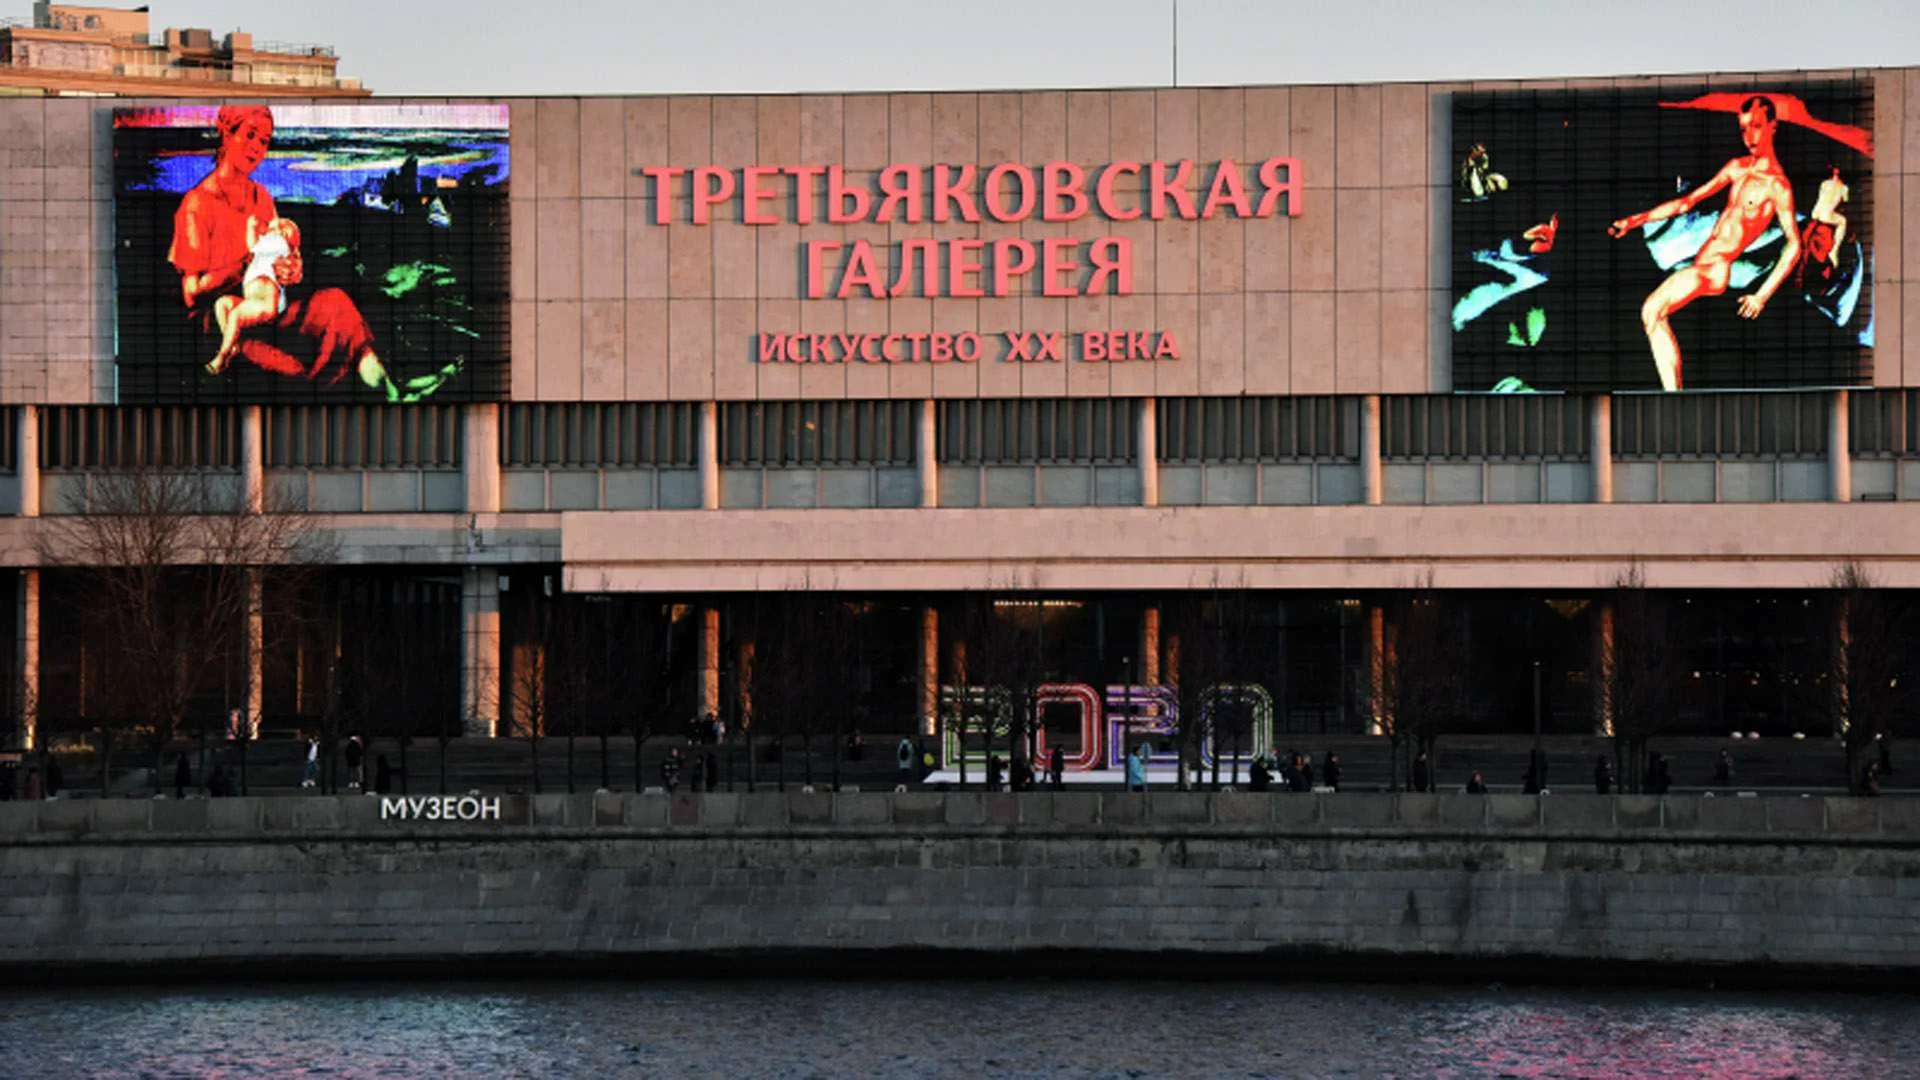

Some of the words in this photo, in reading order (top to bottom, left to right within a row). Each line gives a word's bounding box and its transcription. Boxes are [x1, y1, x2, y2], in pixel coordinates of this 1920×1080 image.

[643, 156, 1303, 224] ТРЕТЬЯКОВСКАЯ
[808, 236, 1133, 299] ГАЛЕРЕЯ
[759, 331, 983, 363] ИСКУССТВО
[1083, 329, 1181, 360] ВЕКА
[380, 797, 500, 820] МУЗЕОН
